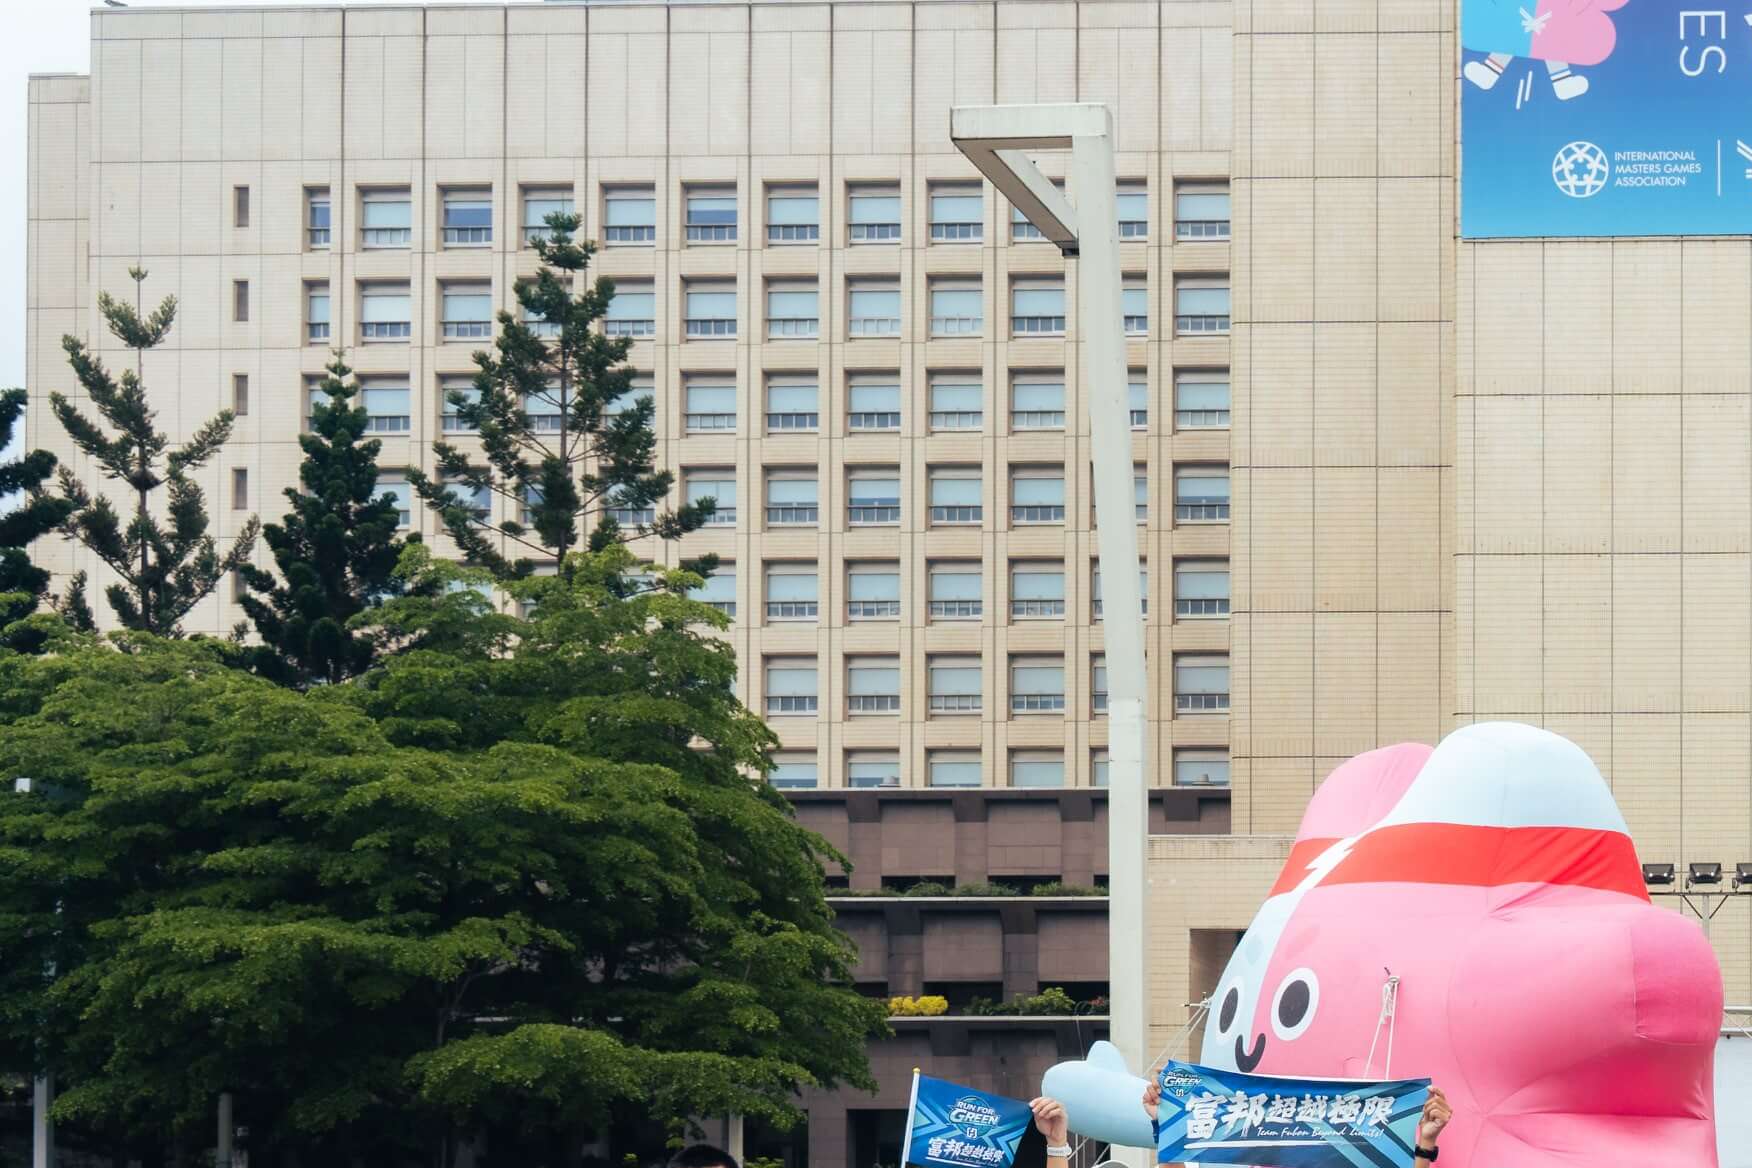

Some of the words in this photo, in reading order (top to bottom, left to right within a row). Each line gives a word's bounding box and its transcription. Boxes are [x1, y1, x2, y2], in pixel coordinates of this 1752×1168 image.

[1614, 151, 1697, 161] INTERNATIONAL
[1615, 163, 1662, 174] MASTERS
[1663, 163, 1701, 173] GAMES
[1614, 176, 1686, 187] ASSOCIATION
[1163, 1075, 1202, 1087] GREEN
[956, 1101, 977, 1112] RUN
[977, 1106, 996, 1116] FOR
[1184, 1090, 1396, 1139] 富邦超越極限
[949, 1107, 999, 1126] GREEN
[1256, 1127, 1279, 1137] Team
[1280, 1126, 1309, 1137] Fubon
[1311, 1126, 1346, 1139] Beyond
